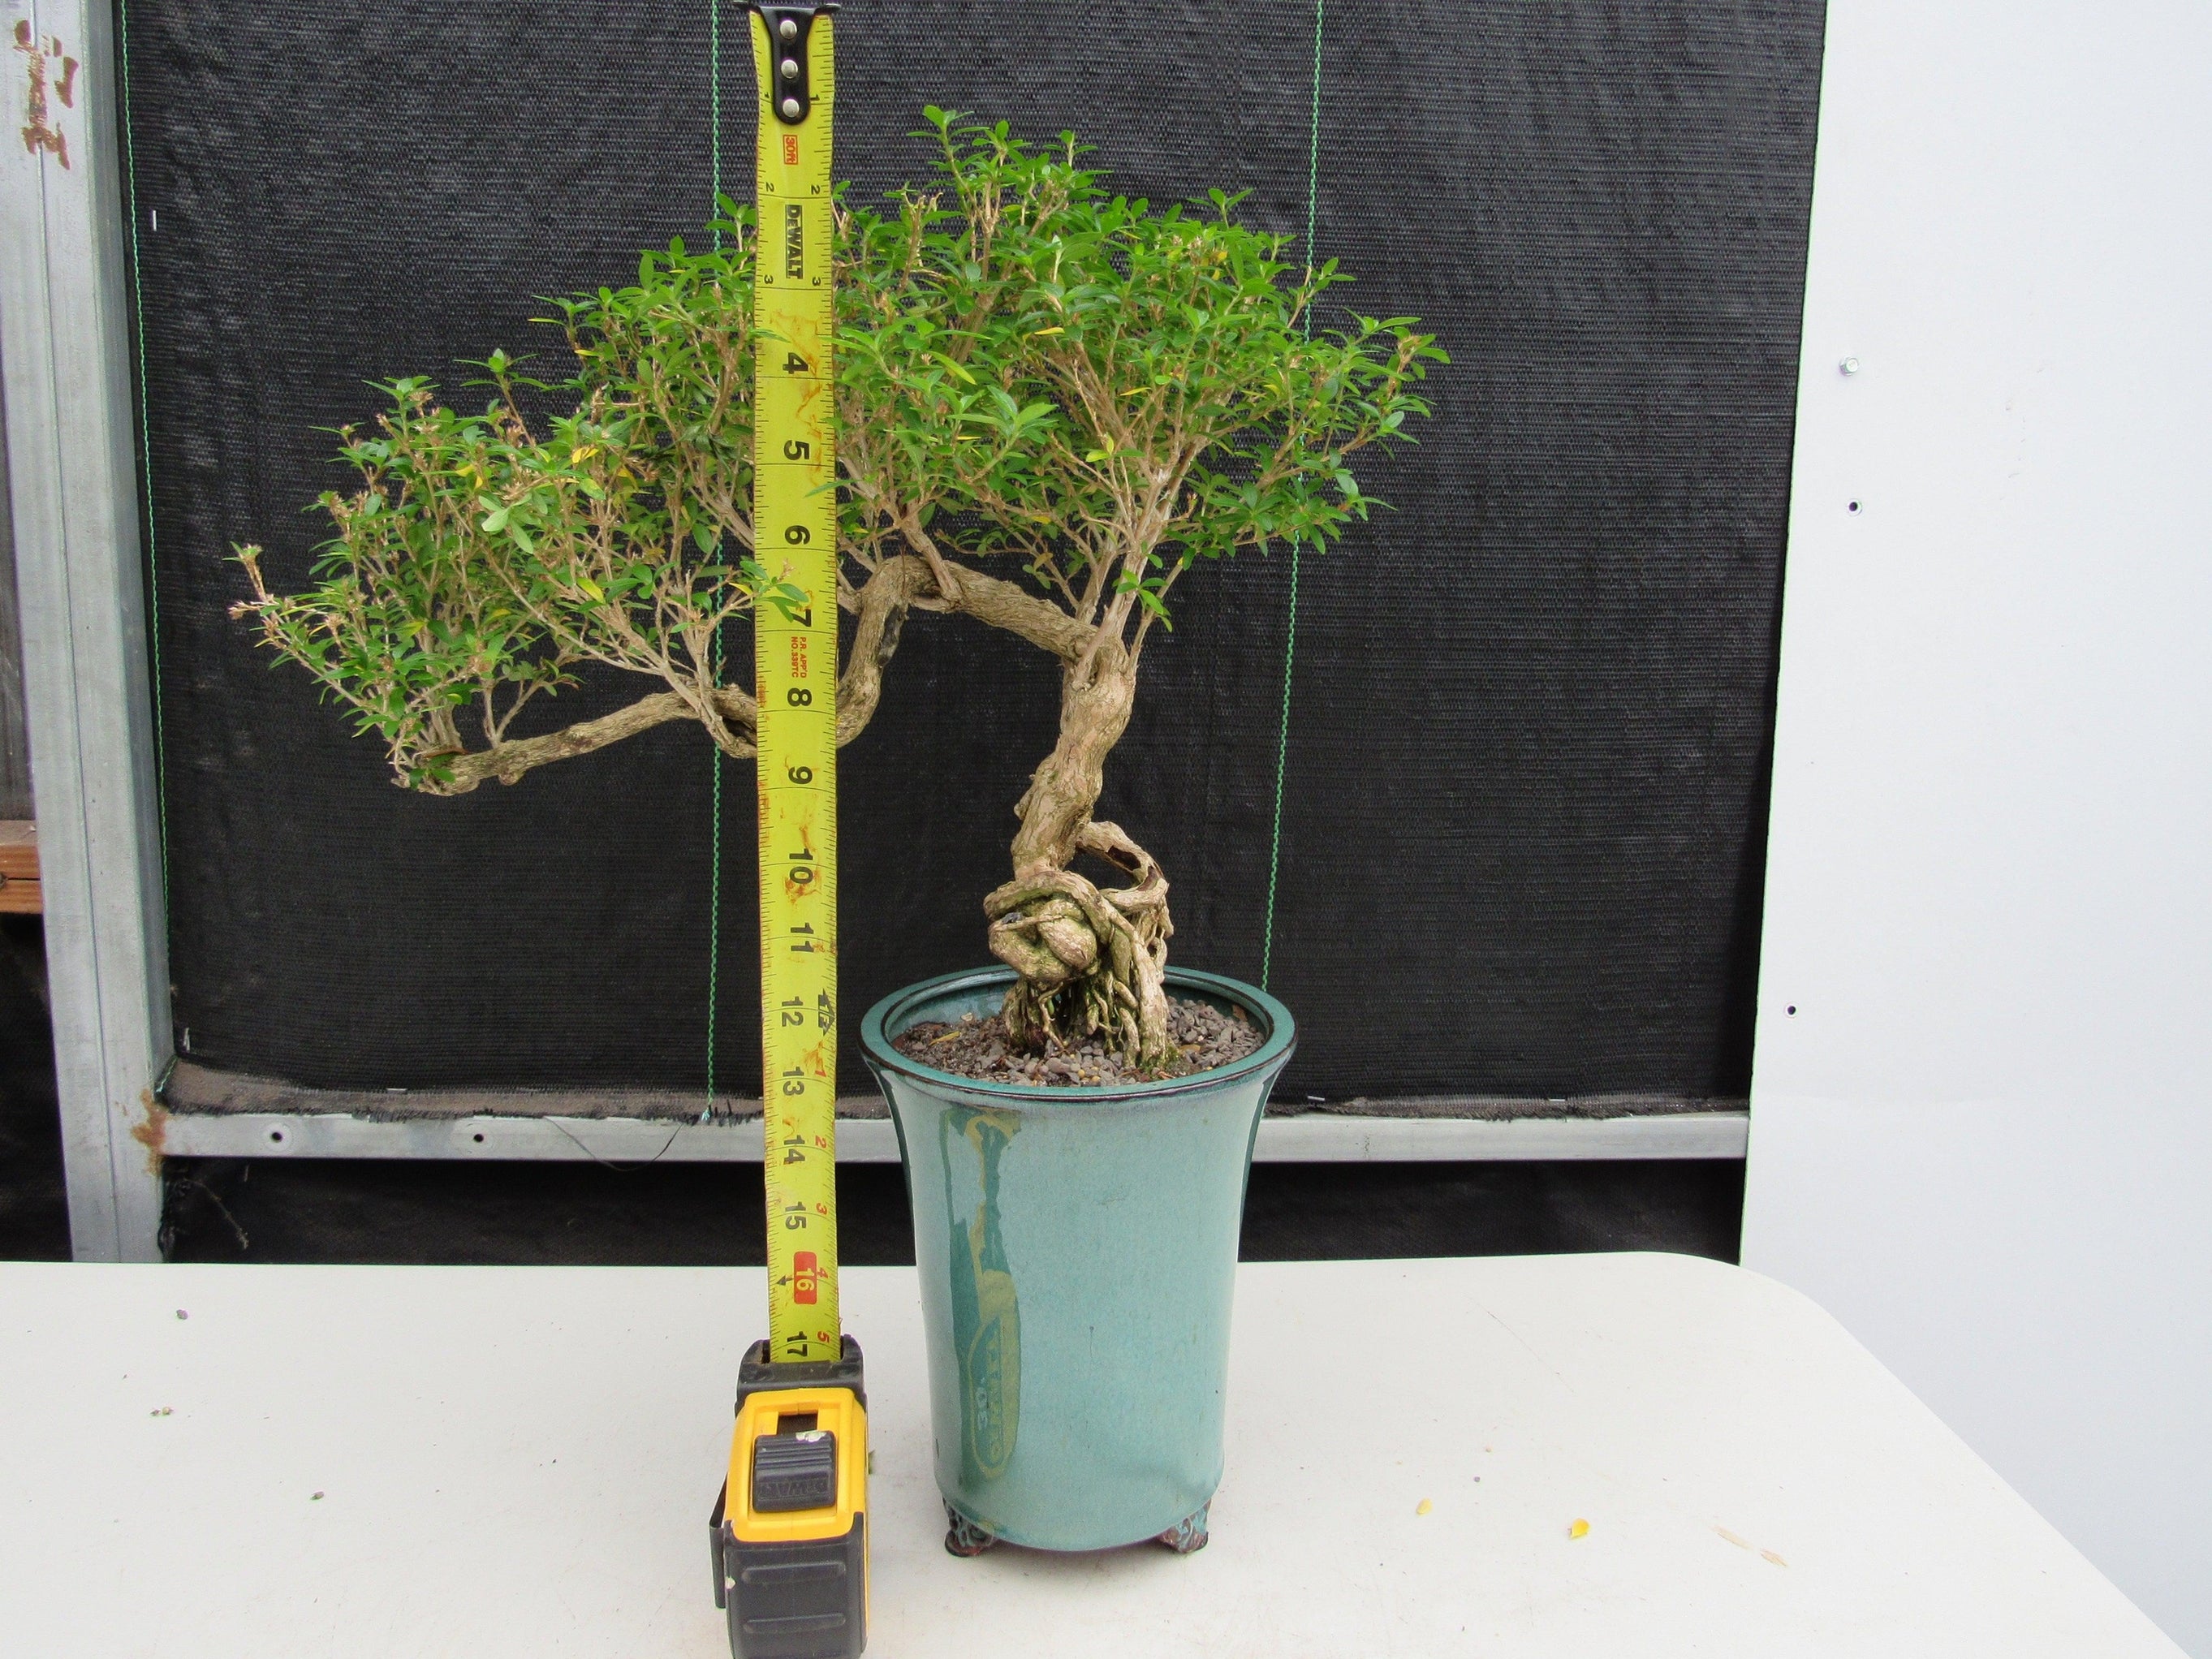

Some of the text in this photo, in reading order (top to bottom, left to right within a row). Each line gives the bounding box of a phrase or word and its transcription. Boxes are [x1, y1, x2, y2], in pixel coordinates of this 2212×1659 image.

[785, 136, 796, 163] 30ft
[765, 183, 774, 192] 2
[811, 184, 821, 195] 2
[786, 205, 803, 279] DEWALT
[764, 274, 774, 284] 3
[812, 276, 821, 286] 3
[783, 352, 808, 374] 4
[783, 440, 810, 460] 5
[784, 525, 811, 545] 6
[791, 609, 812, 627] 7
[787, 687, 813, 707] 8
[788, 766, 813, 785] 9
[789, 848, 813, 884] 10
[790, 922, 814, 953] 11
[781, 996, 804, 1028] 12
[783, 1066, 805, 1096] 13
[783, 1135, 806, 1166] 14
[815, 1135, 827, 1148] 2
[785, 1201, 807, 1230] 15
[816, 1202, 827, 1215] 3
[796, 1268, 815, 1291] 16
[817, 1267, 829, 1279] 4
[787, 1331, 808, 1357] 17
[817, 1331, 830, 1343] 5
